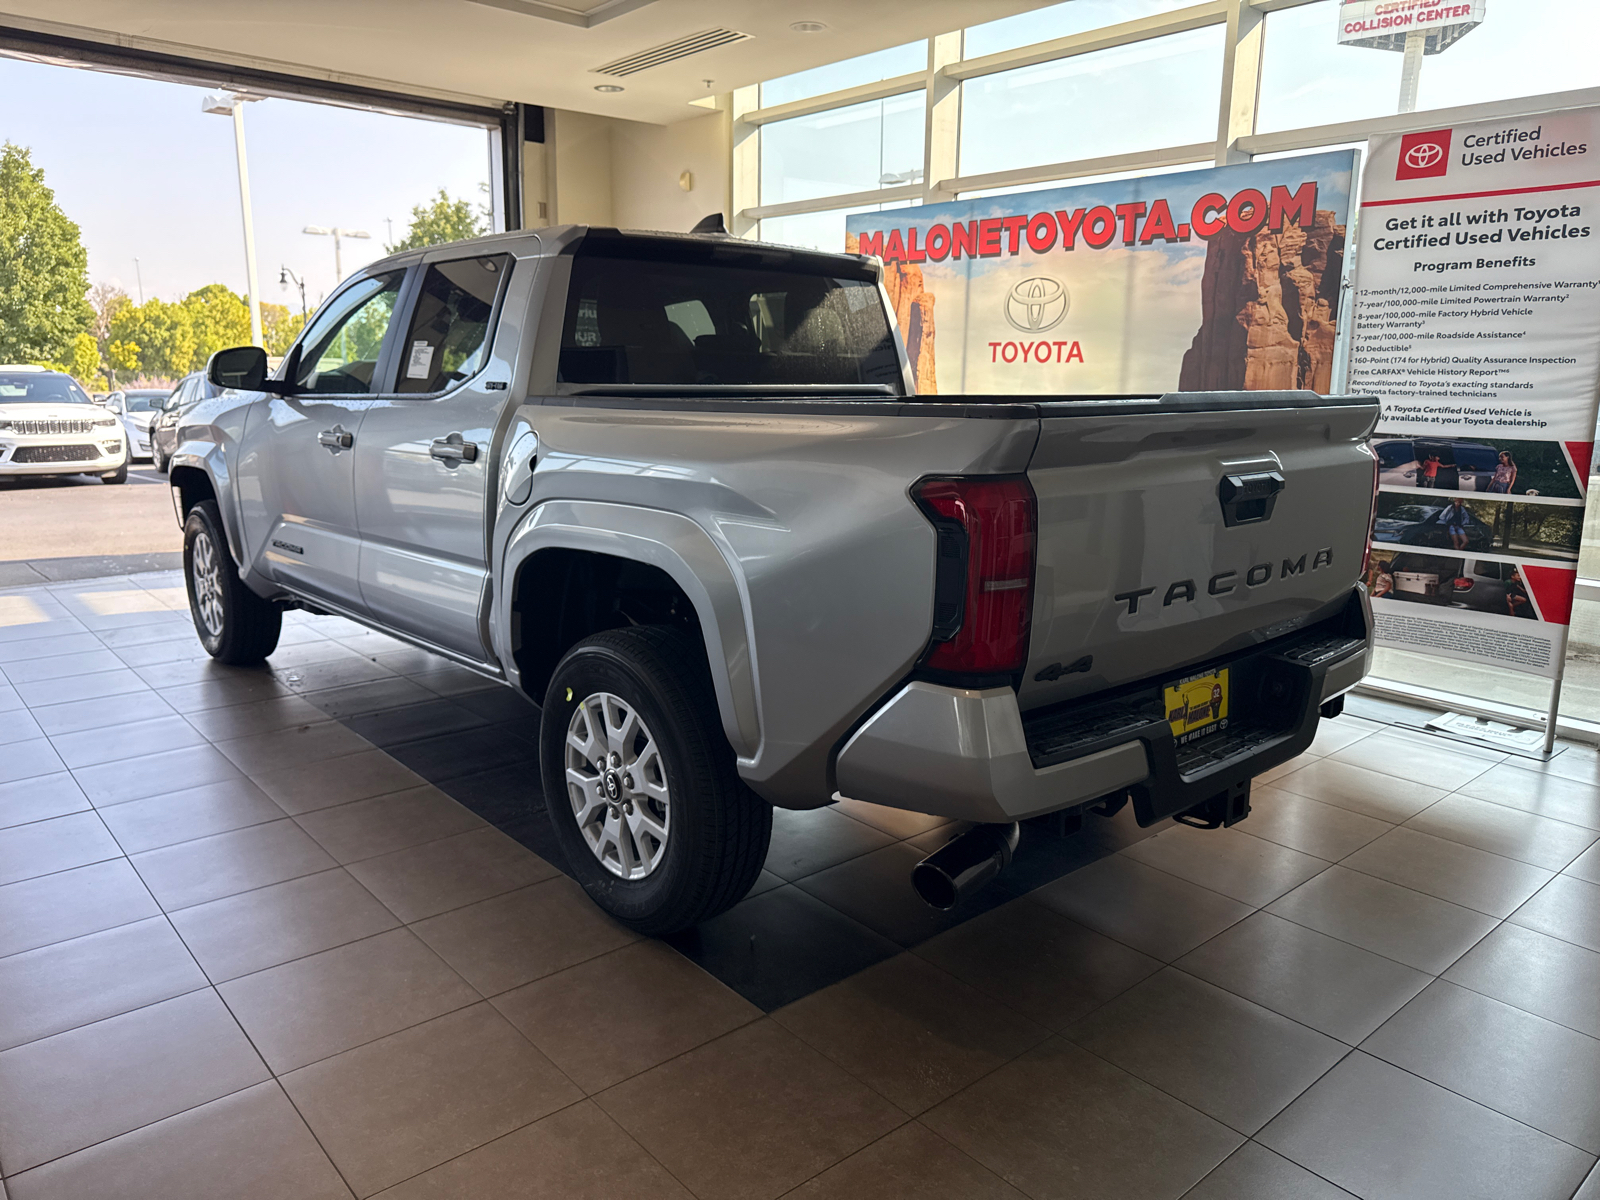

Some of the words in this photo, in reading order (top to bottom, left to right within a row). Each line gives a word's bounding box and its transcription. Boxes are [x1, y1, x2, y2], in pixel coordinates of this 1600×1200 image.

[1344, 14, 1413, 34] COLLISION
[1416, 4, 1471, 22] CENTER
[1463, 126, 1542, 148] Certified
[1461, 150, 1505, 166] Used
[1510, 142, 1587, 161] Vehicles
[859, 181, 1319, 265] MALONETOYOTA.COM
[1385, 217, 1418, 231] Get
[1421, 215, 1434, 229] it
[1438, 212, 1462, 227] all
[1466, 209, 1508, 225] with
[1514, 204, 1581, 224] Toyota
[1373, 233, 1451, 251] Certified
[1455, 229, 1502, 245] Used
[1507, 224, 1591, 242] Vehicles
[1414, 259, 1473, 273] Program
[1476, 256, 1536, 269] Benefits
[1360, 285, 1448, 296] 12-month/12,000-mile
[1449, 284, 1481, 292] Limited
[1483, 281, 1552, 291] Comprehensive
[1359, 298, 1438, 309] 7-year/100,000-mile
[1440, 297, 1472, 305] Limited
[1474, 295, 1521, 304] Powertrain
[1358, 310, 1436, 321] 8-year/100,000-mile
[1438, 310, 1469, 318] Factory
[1471, 309, 1499, 317] Hybrid
[1501, 308, 1533, 316] Vehicle
[1356, 331, 1434, 341] 7-year/100,000-mile
[1436, 331, 1474, 339] Roadside
[988, 340, 1085, 364] TOYOTA
[1391, 356, 1406, 364] (174
[1408, 356, 1419, 364] for
[1420, 356, 1450, 364] Hybrid)
[1452, 356, 1482, 365] Quality
[1529, 356, 1576, 365] Inspection
[1437, 369, 1467, 377] History
[1452, 381, 1488, 389] exacting
[1388, 389, 1447, 397] factory-trained
[1394, 405, 1422, 413] Toyota
[1423, 406, 1462, 414] Certified
[1489, 408, 1522, 416] Vehicle
[1390, 415, 1429, 423] available
[1463, 417, 1494, 426] Toyota
[1495, 418, 1547, 428] dealership
[1114, 546, 1334, 616] TACOMA
[1213, 688, 1220, 698] 32
